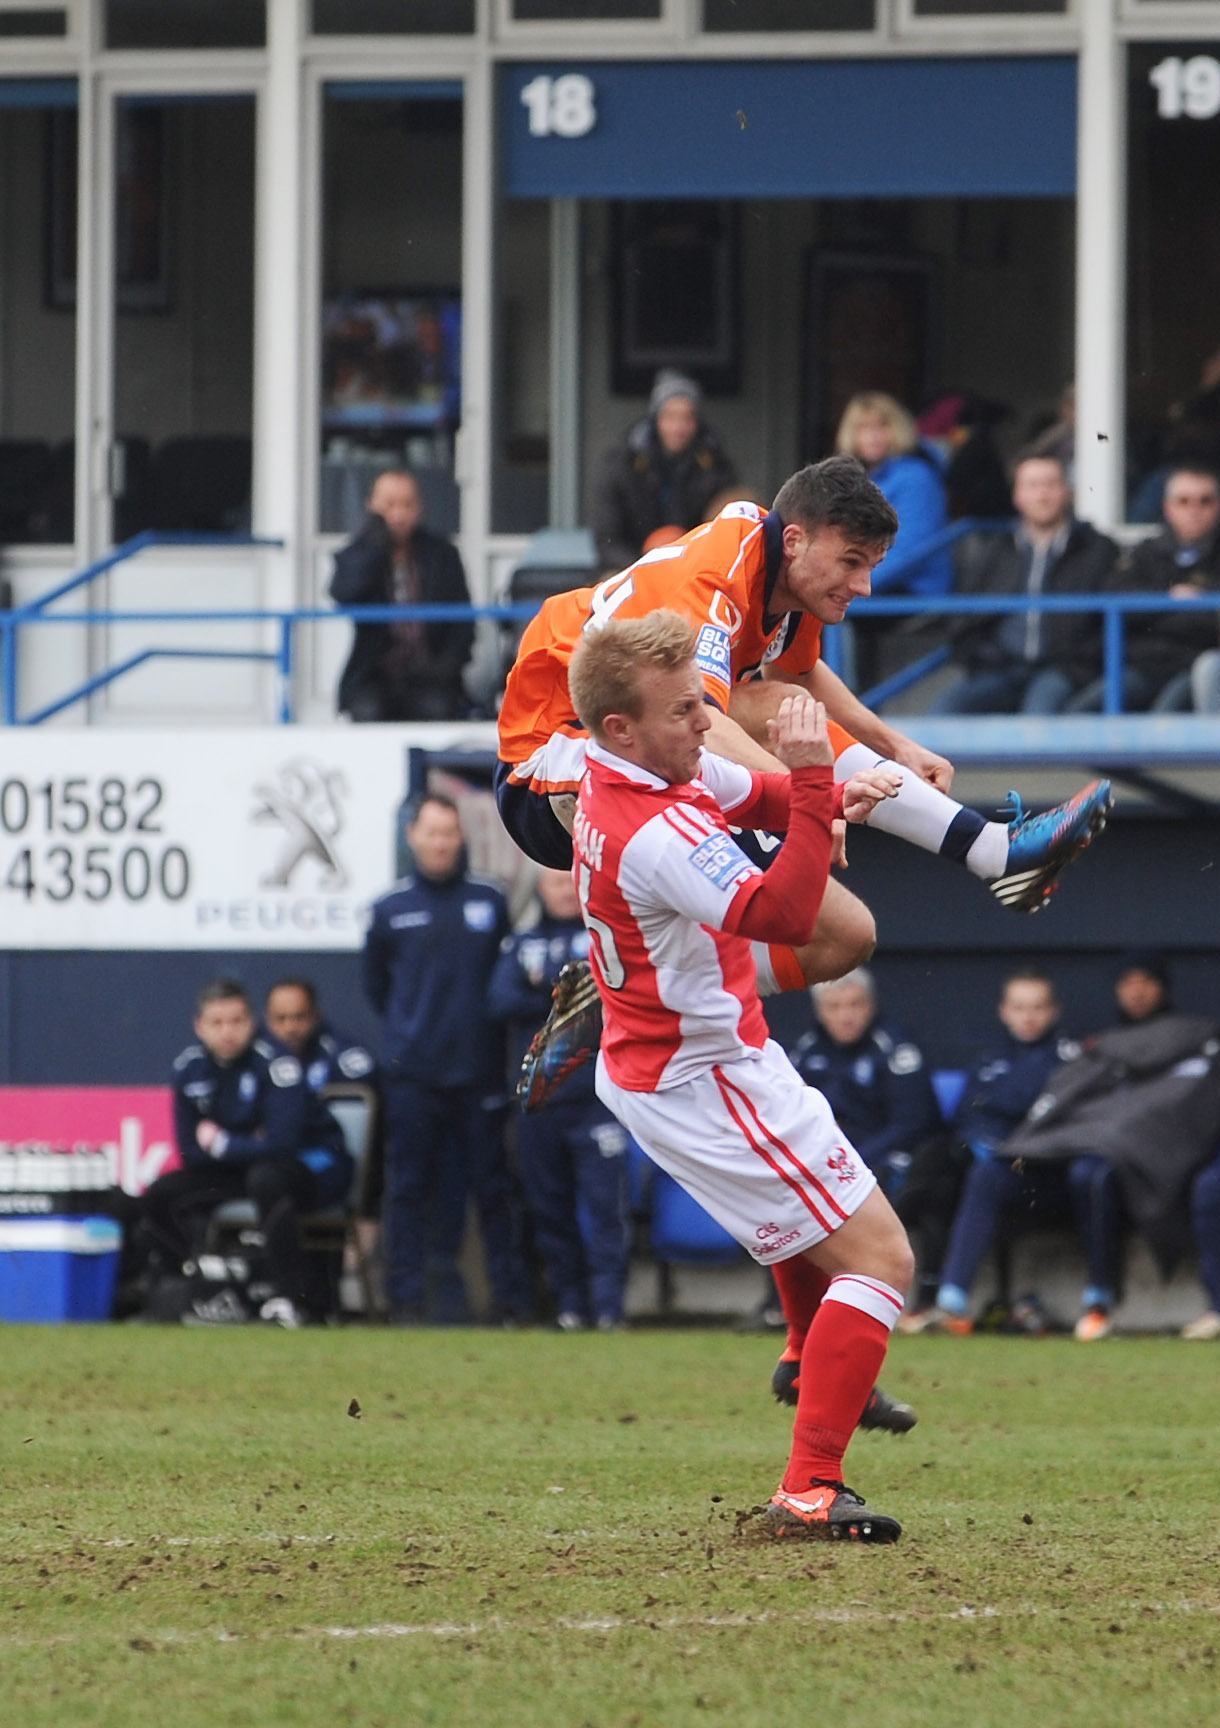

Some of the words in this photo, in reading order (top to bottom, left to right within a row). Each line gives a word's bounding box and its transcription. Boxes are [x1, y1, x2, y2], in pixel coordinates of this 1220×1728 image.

[519, 73, 596, 138] 18
[1, 778, 163, 835] 01582
[751, 1229, 802, 1256] Solicitors
